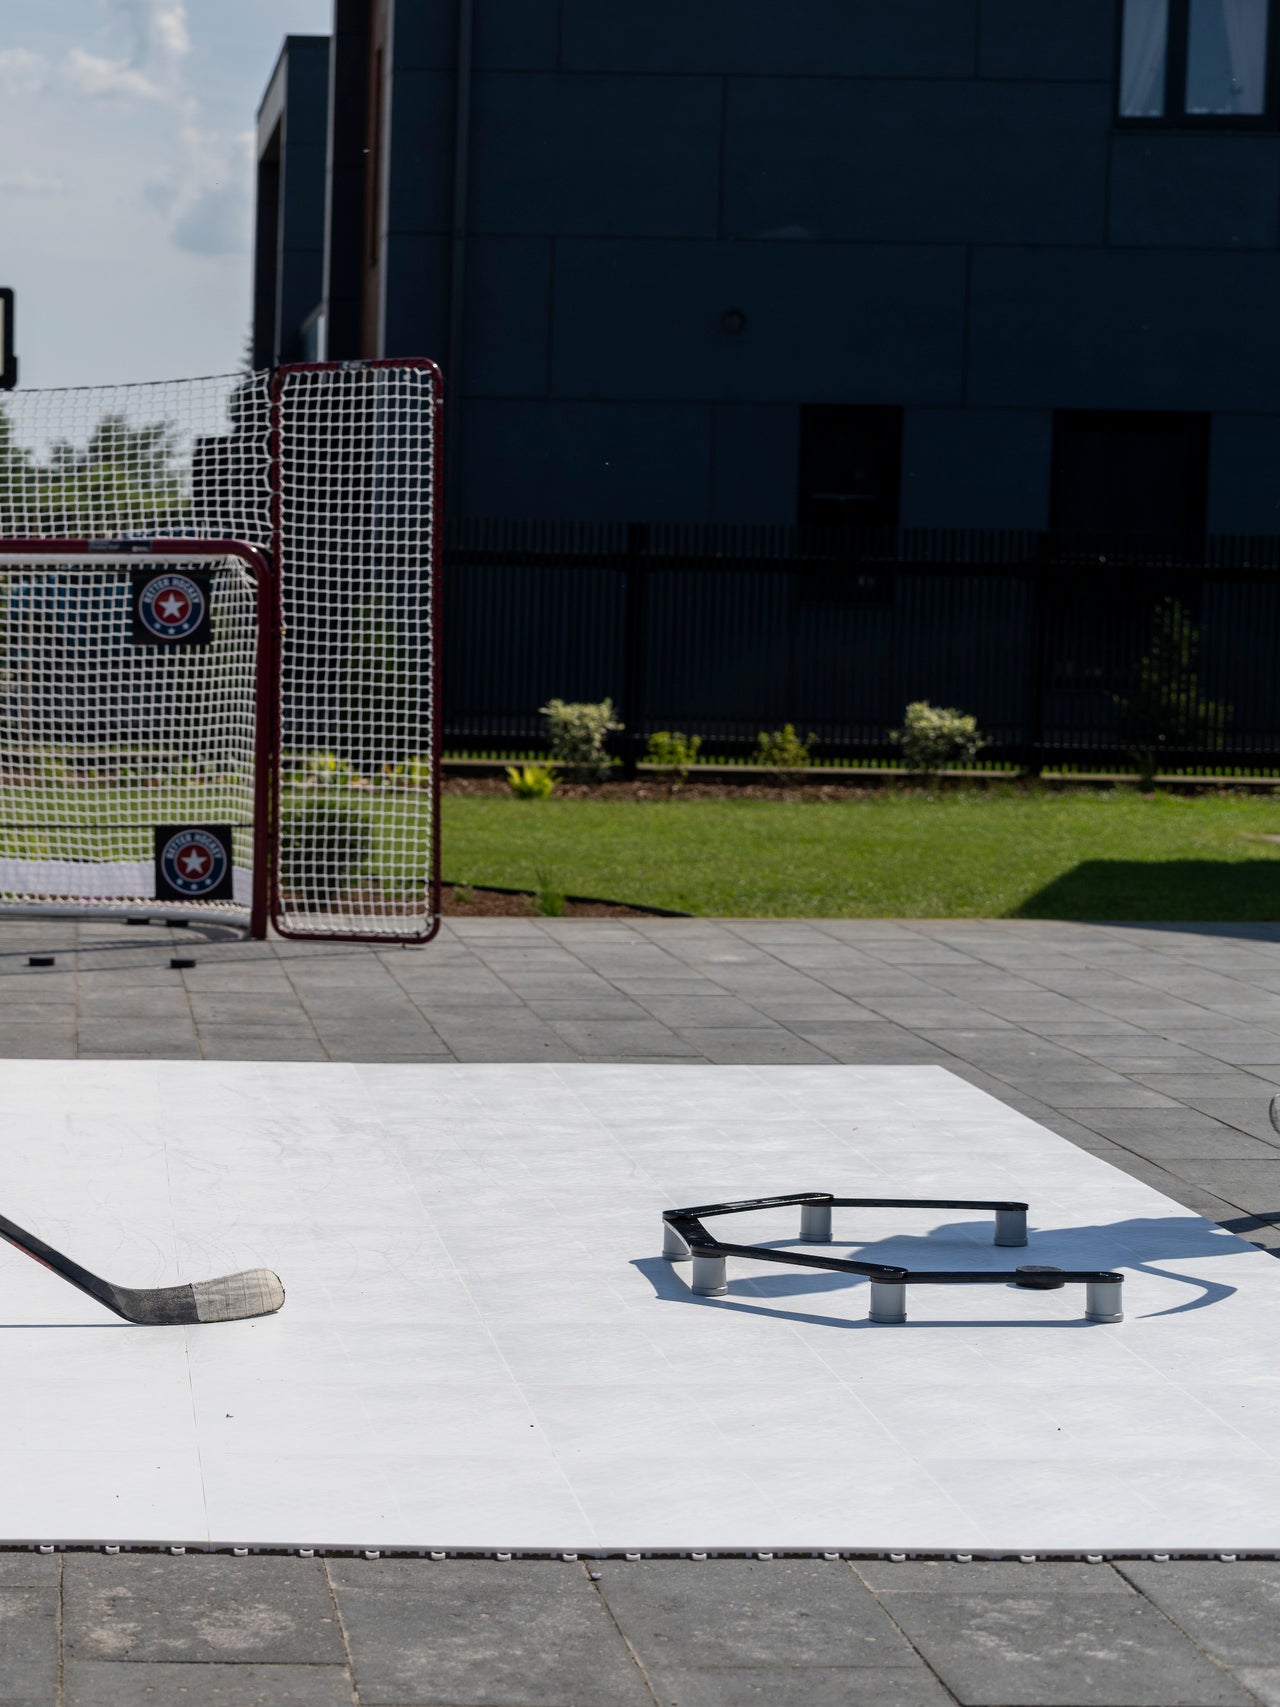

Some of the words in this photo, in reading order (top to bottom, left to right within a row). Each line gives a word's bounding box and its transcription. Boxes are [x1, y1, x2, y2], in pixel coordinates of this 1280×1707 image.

[143, 577, 170, 603] BETTER
[171, 577, 200, 603] HOCKEY
[165, 833, 191, 859] BETTER
[193, 833, 222, 859] HOCKEY
